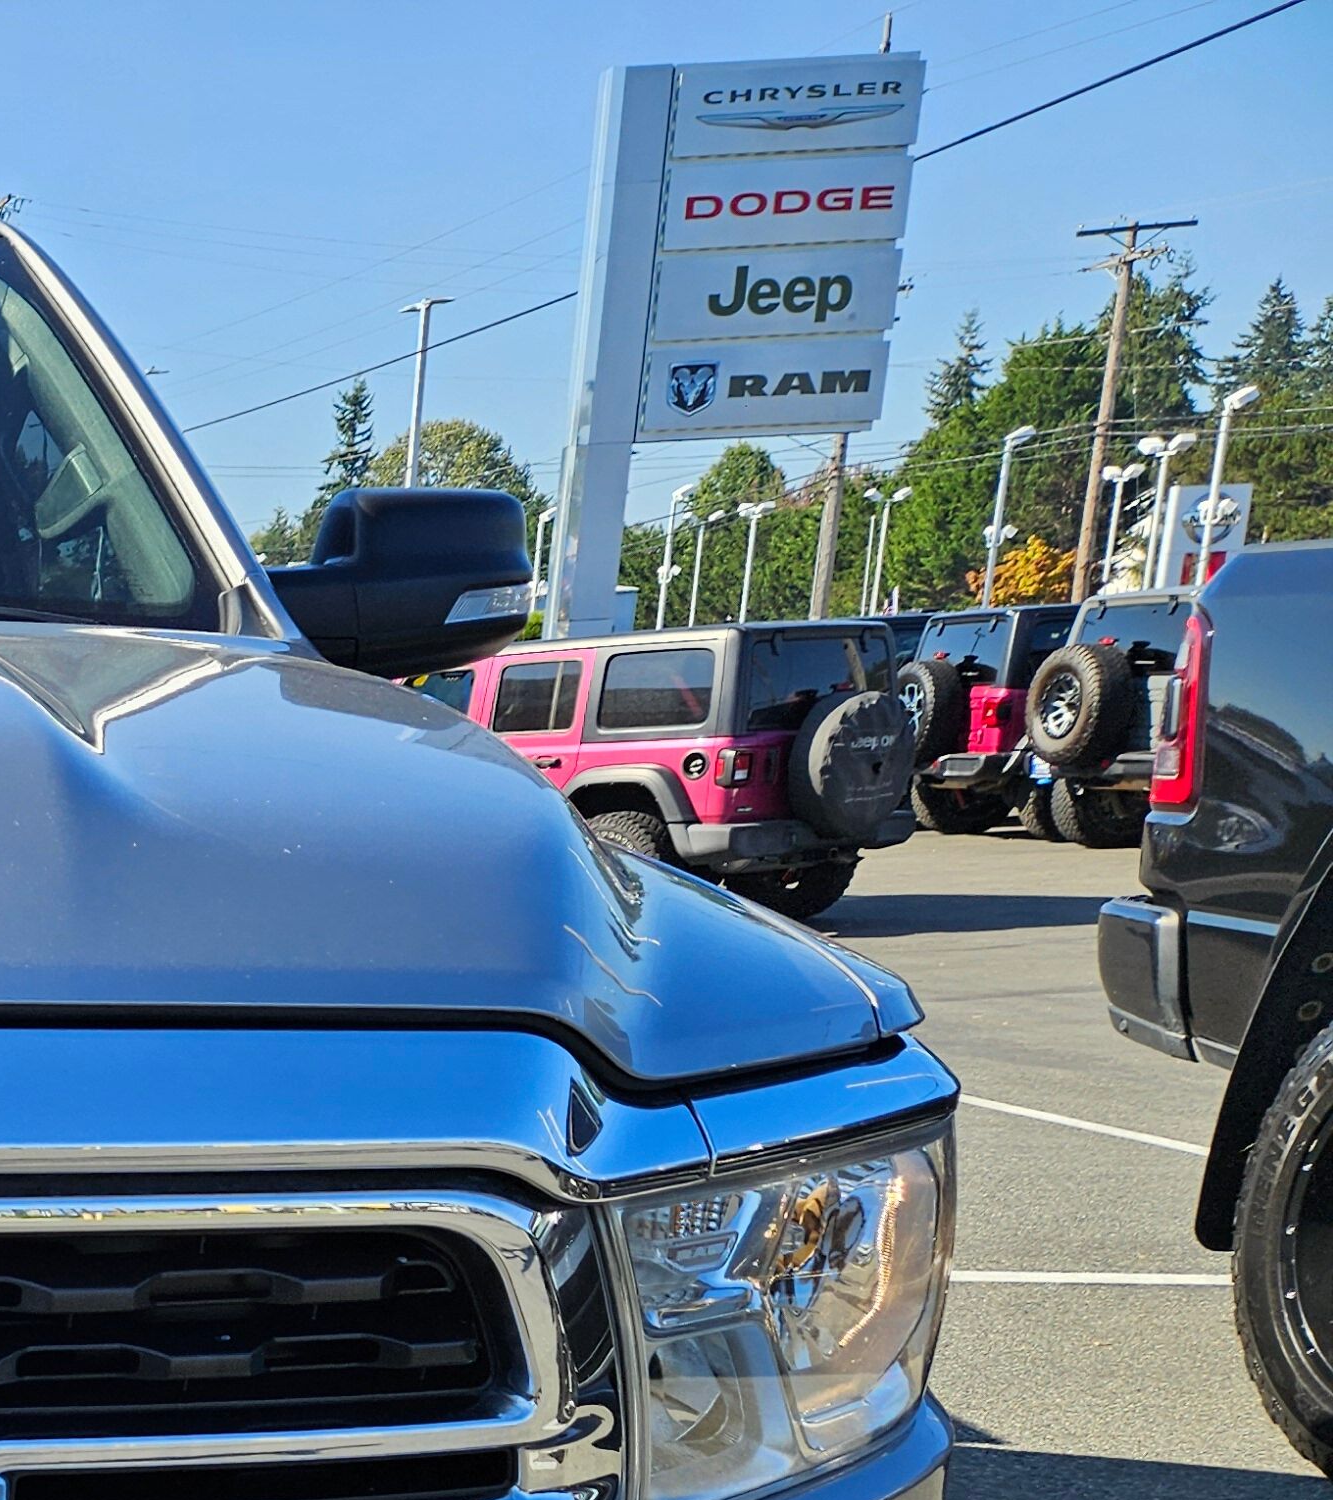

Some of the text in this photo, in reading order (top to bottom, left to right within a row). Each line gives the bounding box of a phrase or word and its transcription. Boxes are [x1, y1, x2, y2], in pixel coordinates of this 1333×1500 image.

[703, 81, 902, 104] CHRYSLER
[684, 185, 895, 220] DODGE
[707, 266, 853, 322] Jeep
[727, 369, 872, 399] RAM
